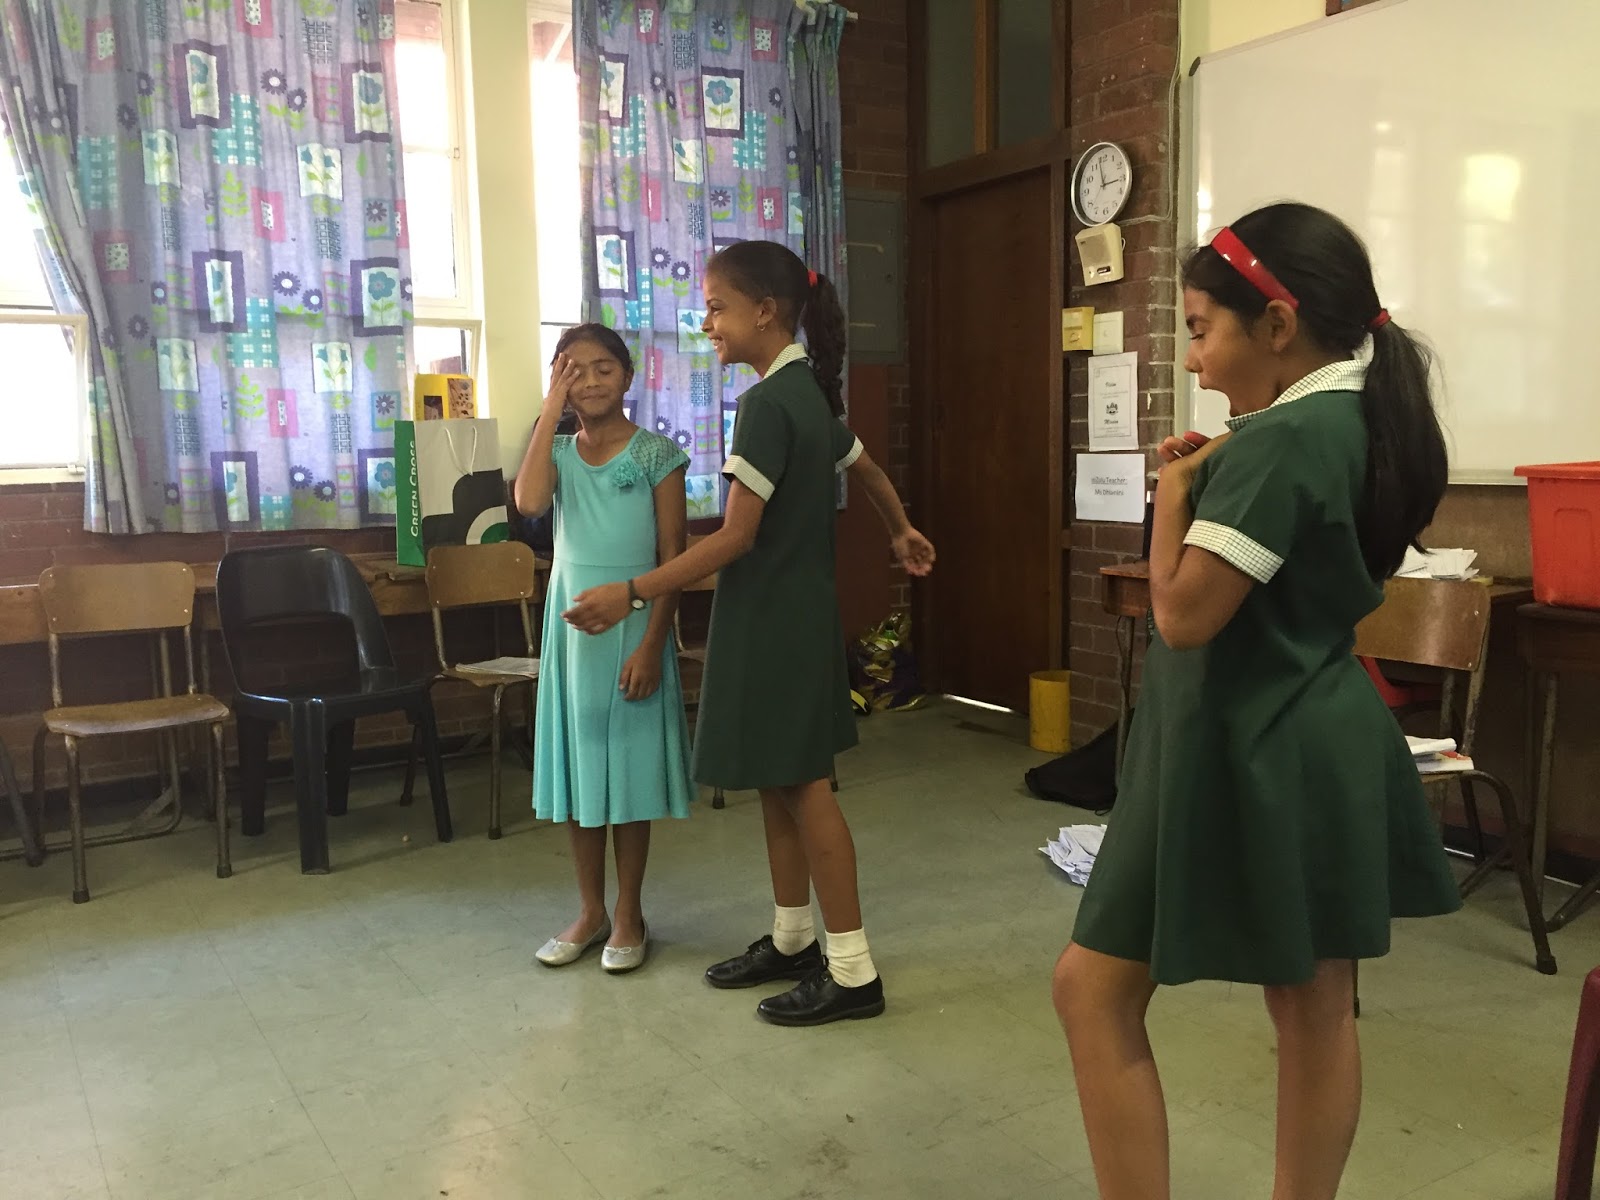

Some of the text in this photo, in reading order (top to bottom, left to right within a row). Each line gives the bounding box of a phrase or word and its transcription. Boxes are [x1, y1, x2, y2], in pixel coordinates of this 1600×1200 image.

[1098, 154, 1108, 164] 12
[1091, 163, 1098, 172] 11
[1086, 176, 1094, 184] 10
